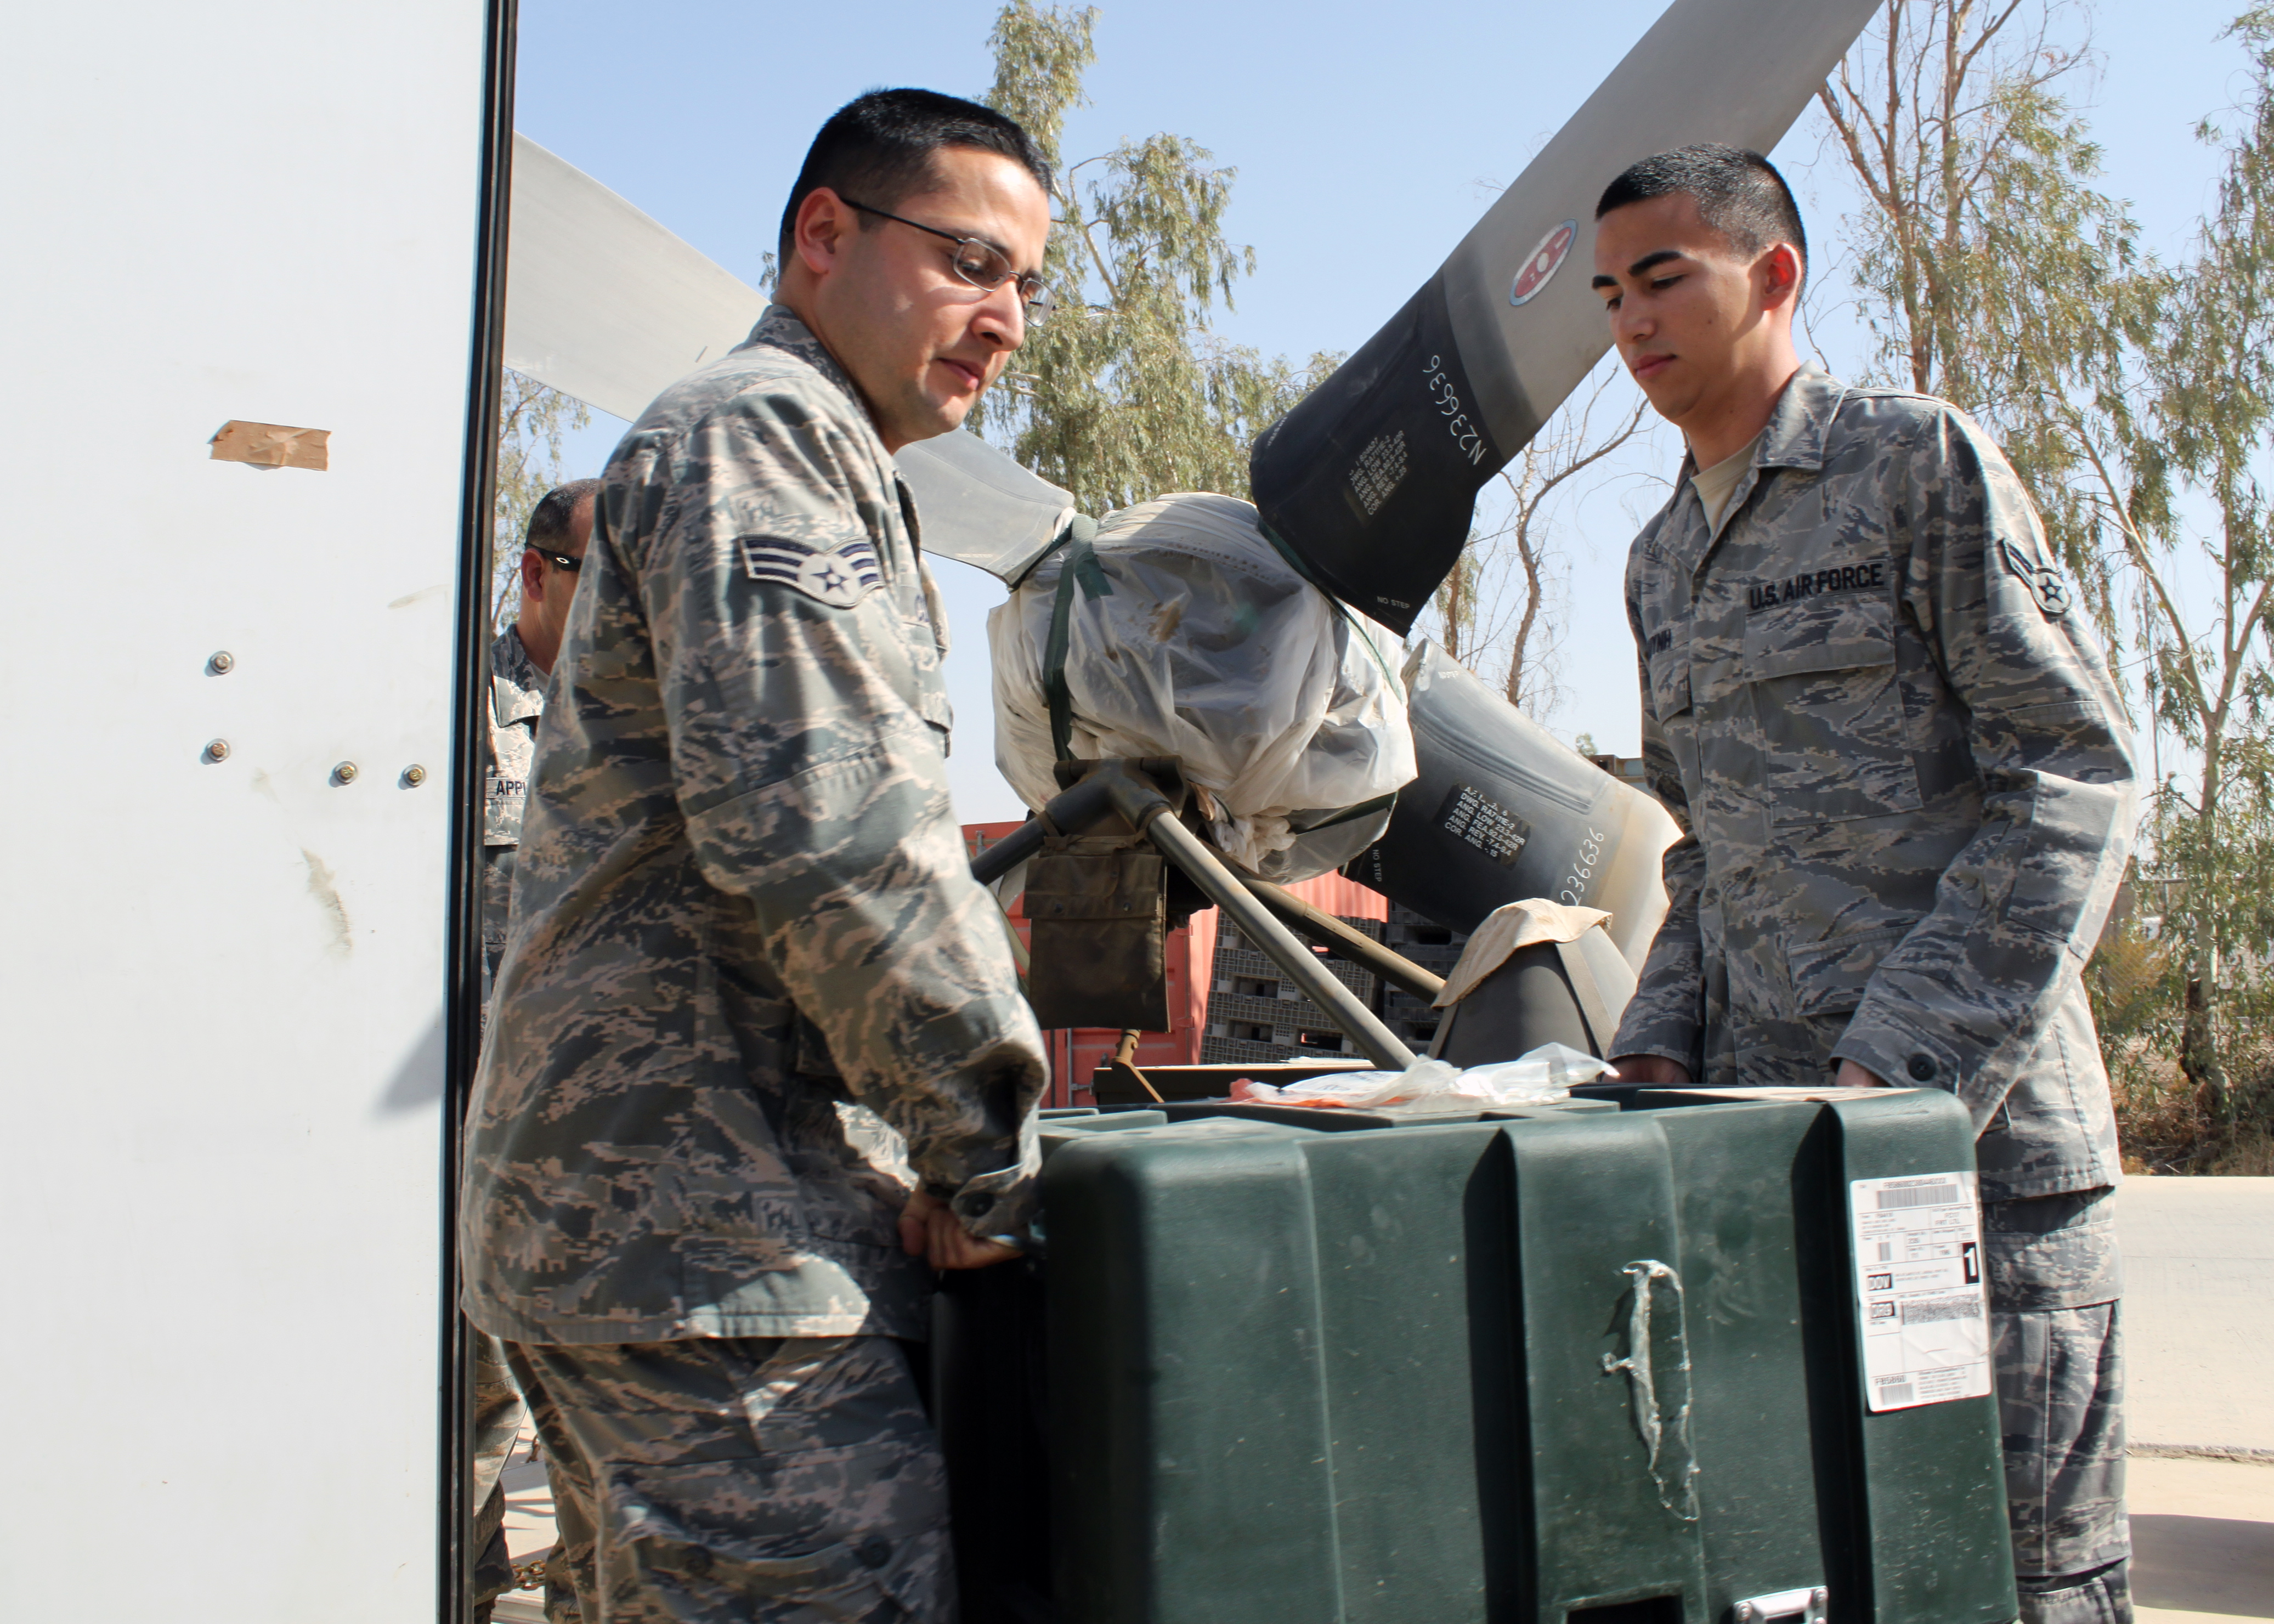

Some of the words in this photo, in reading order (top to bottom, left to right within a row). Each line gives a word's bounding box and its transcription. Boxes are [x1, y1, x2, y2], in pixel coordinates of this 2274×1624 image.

[1423, 355, 1486, 465] N236636
[1354, 477, 1368, 493] ANG.
[1367, 459, 1381, 476] LOW
[1359, 484, 1373, 501] ANG.
[1364, 491, 1377, 508] ANG.
[1376, 474, 1390, 491] REV.
[1367, 499, 1382, 515] COR.
[1382, 482, 1396, 499] ANG.
[1749, 585, 1779, 610] U.S.
[1783, 574, 1812, 602] AIR
[1817, 563, 1884, 593] FORCE
[1391, 599, 1410, 609] STEP
[1456, 801, 1475, 815] ANG.
[1476, 812, 1495, 826] LOW
[1460, 793, 1479, 808] DWG.
[1448, 815, 1466, 830] ANG.
[1468, 827, 1484, 841] REV.
[1452, 808, 1470, 822] ANG.
[1445, 822, 1462, 836] COR.
[1464, 835, 1483, 849] ANG.
[1372, 850, 1380, 860] NO
[1557, 827, 1604, 906] 236636
[1373, 863, 1382, 881] STEP
[1964, 1247, 1977, 1276] 1
